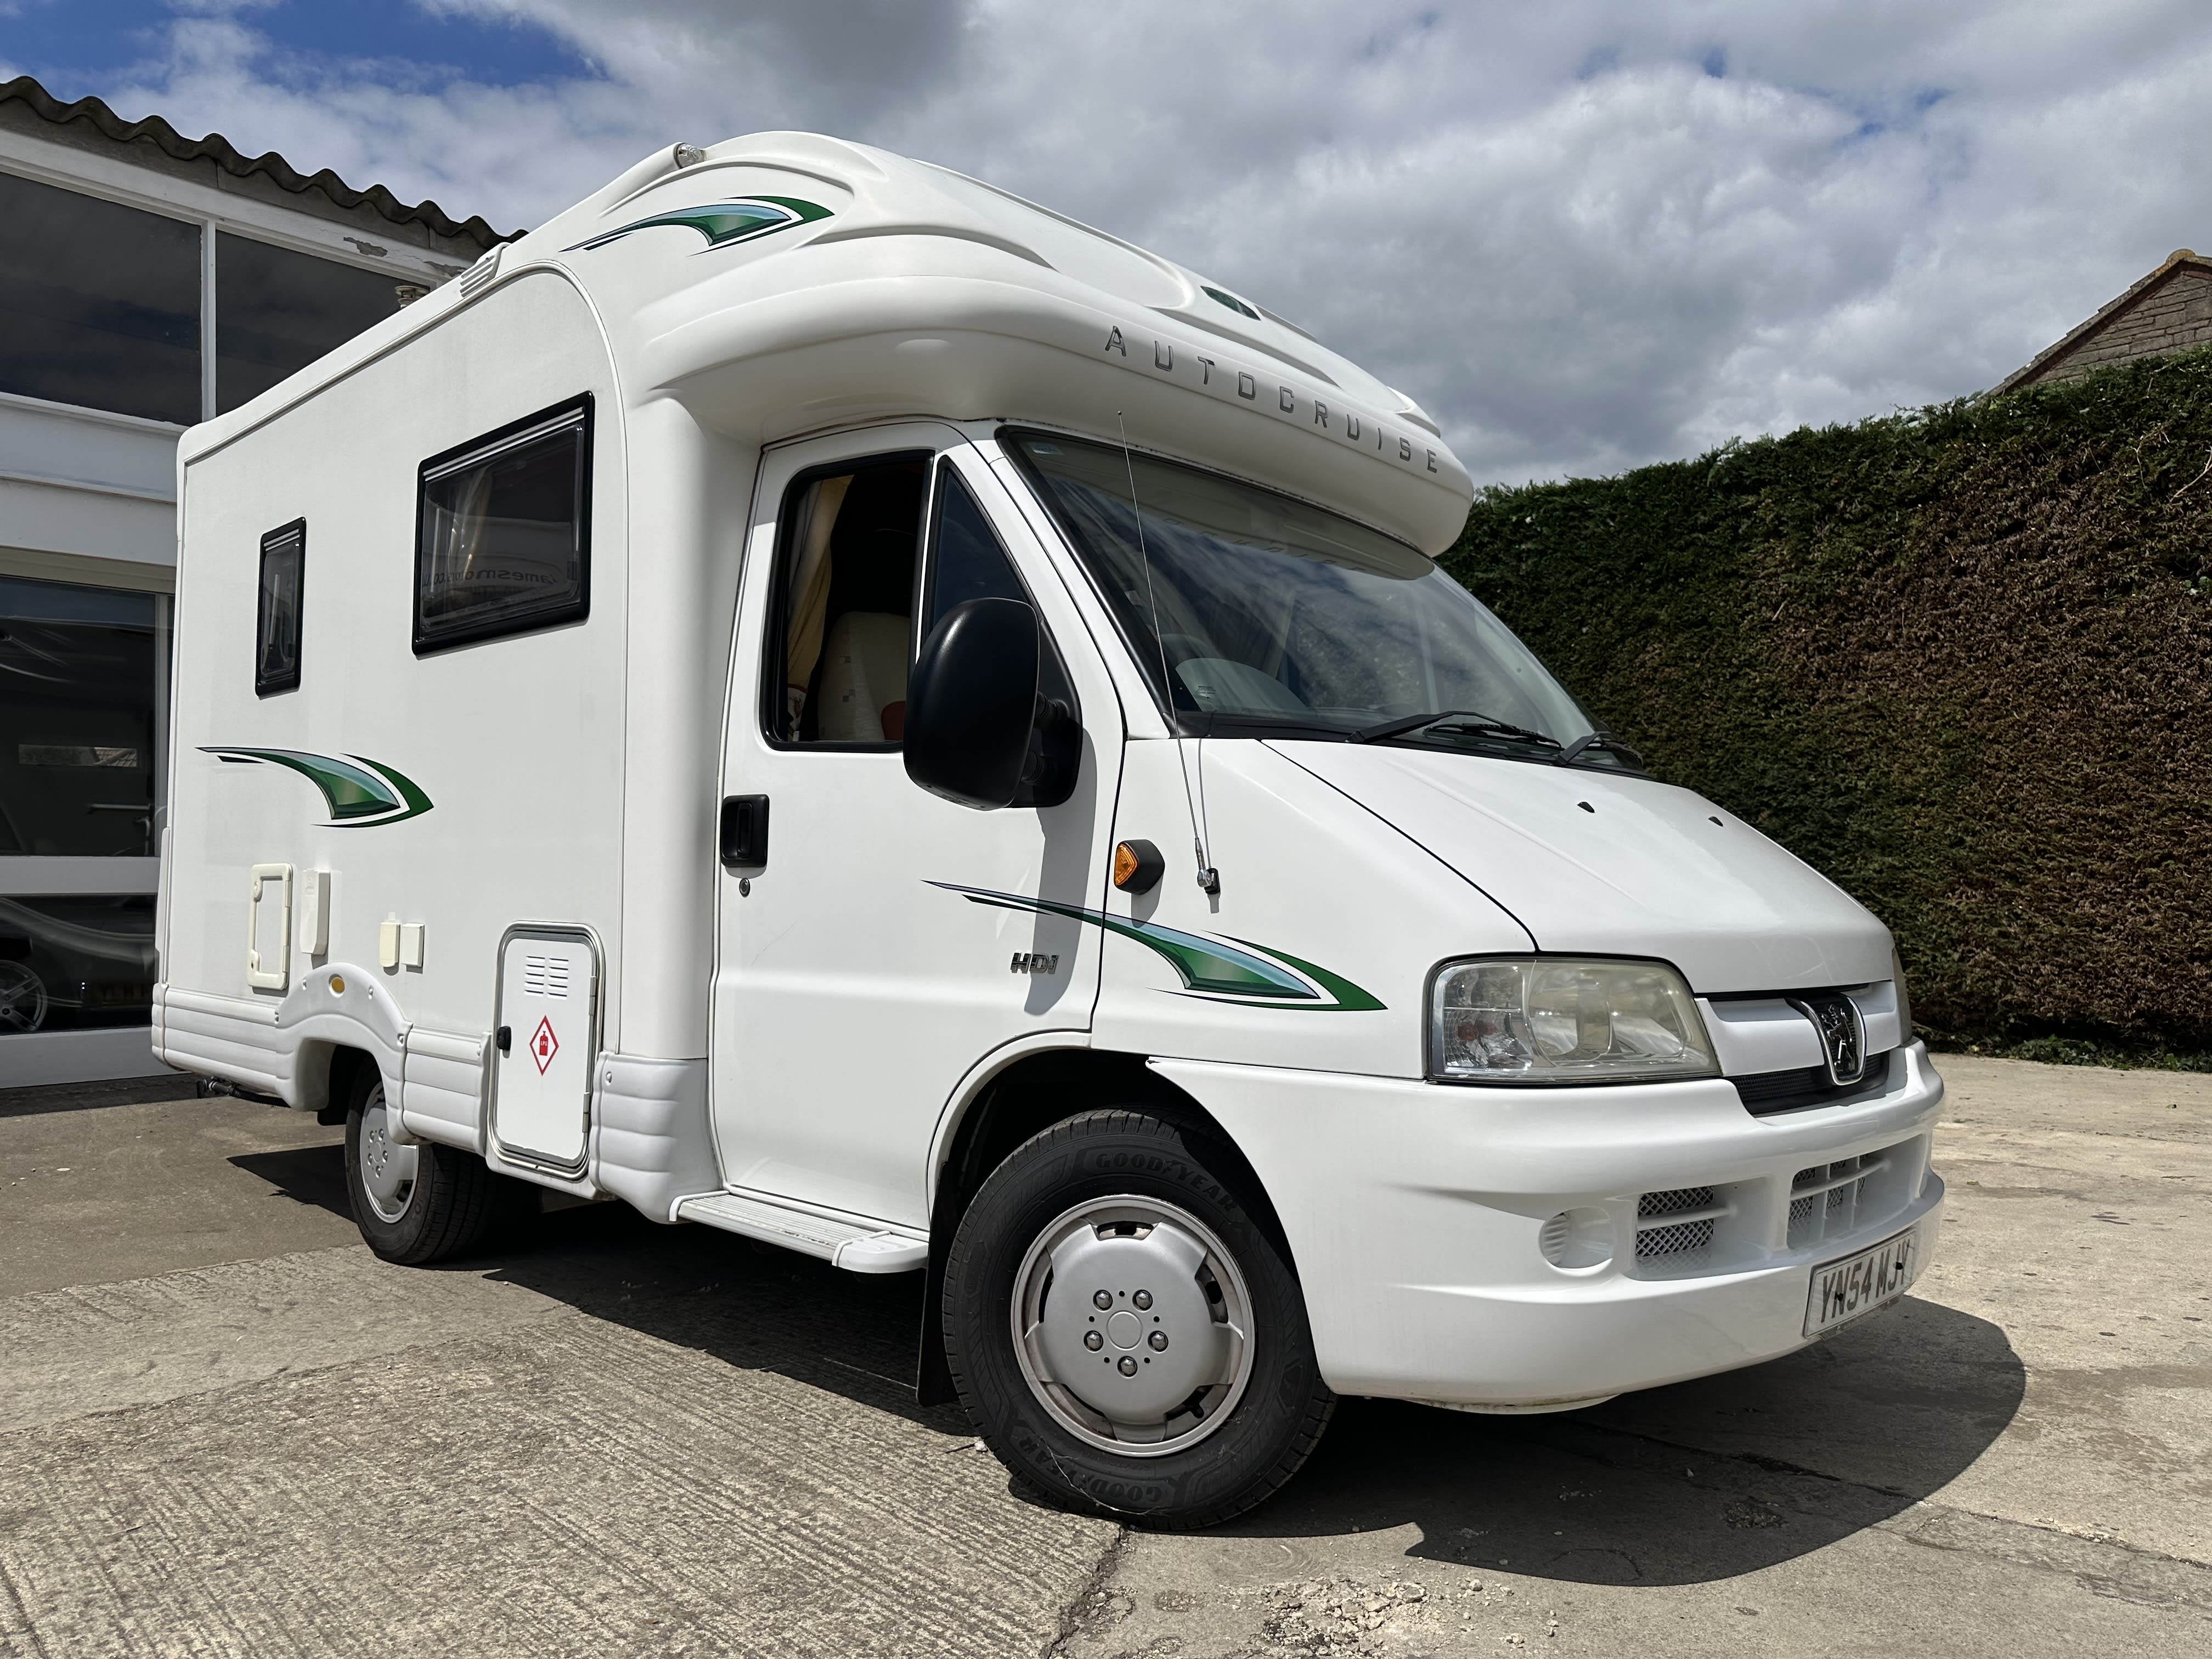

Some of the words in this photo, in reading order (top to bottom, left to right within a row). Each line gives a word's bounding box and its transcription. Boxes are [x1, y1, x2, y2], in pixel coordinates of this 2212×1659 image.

[1105, 325, 1438, 473] AUTOCRUISE
[1820, 1256, 1875, 1323] YN54
[1876, 1238, 1910, 1299] MJY
